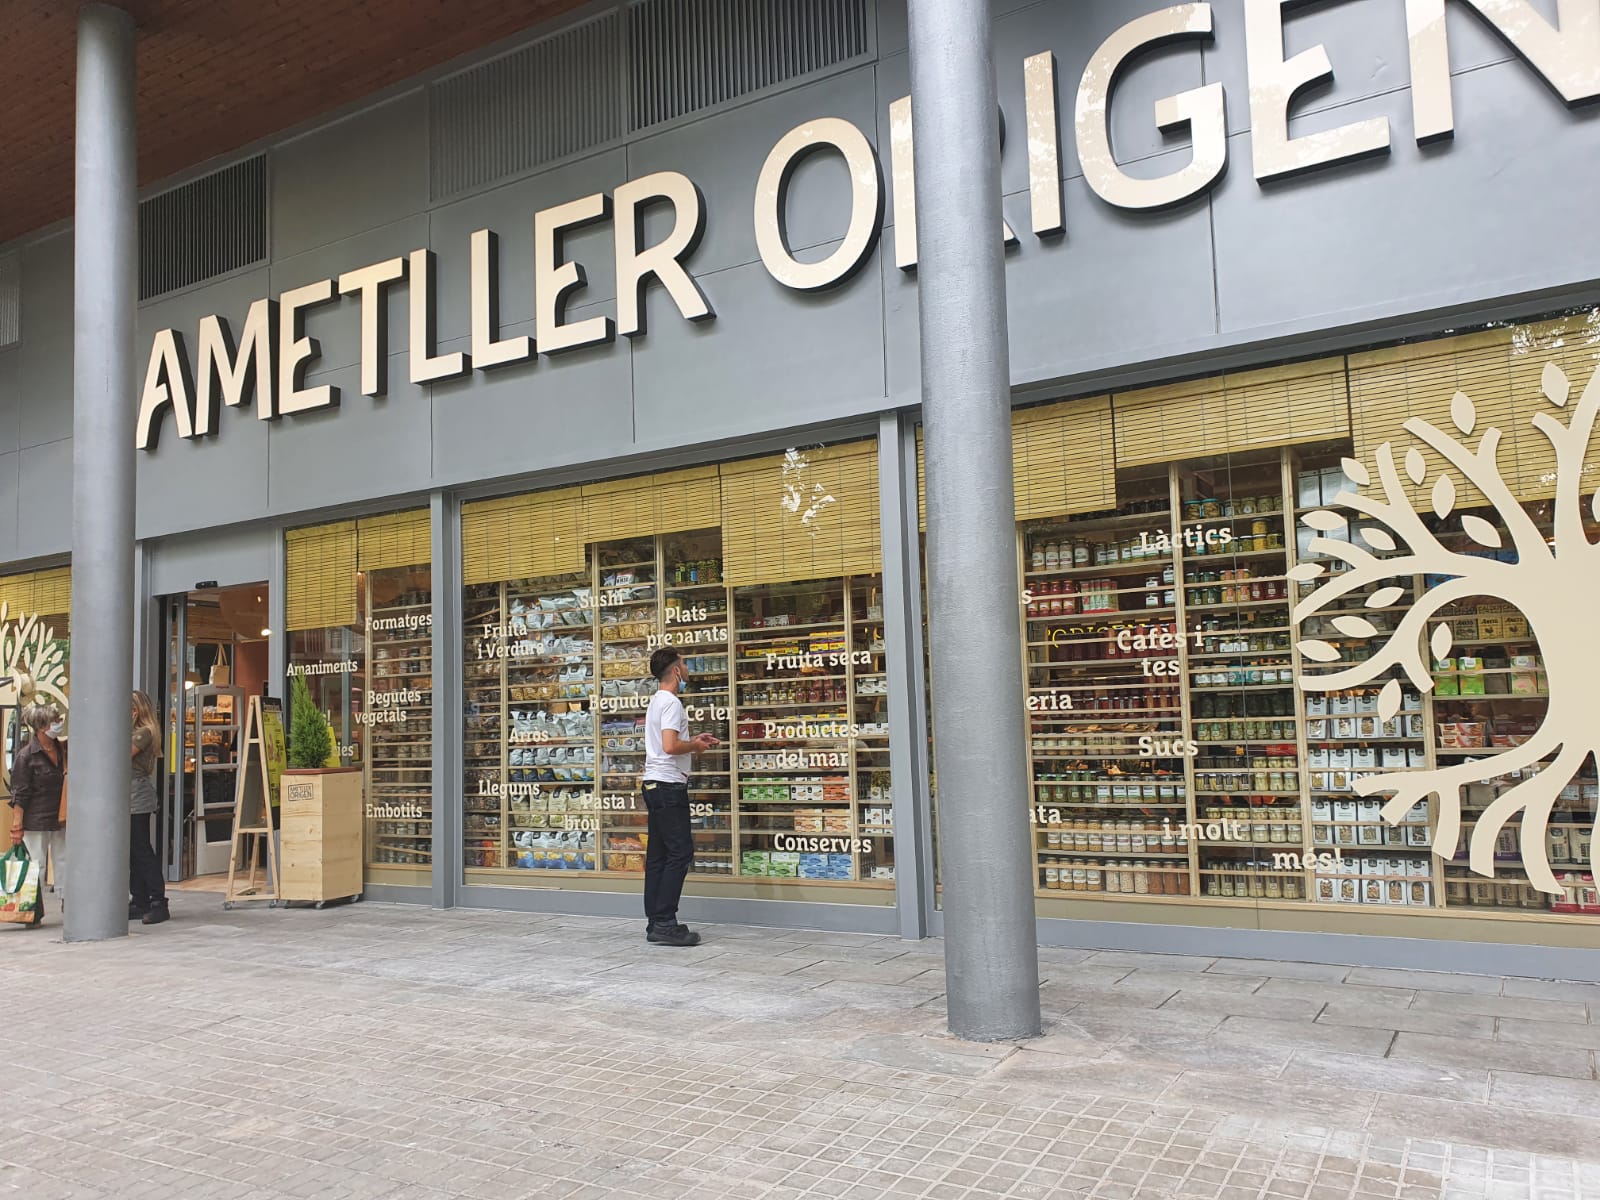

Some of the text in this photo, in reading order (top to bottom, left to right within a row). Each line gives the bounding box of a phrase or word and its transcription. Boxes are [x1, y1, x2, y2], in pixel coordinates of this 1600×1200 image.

[135, 0, 1600, 450] AMETLLER OIGEN
[1138, 524, 1232, 552] Làctics
[365, 613, 433, 631] Formatges
[664, 605, 707, 624] Plats
[483, 623, 528, 639] Fruita
[1117, 628, 1188, 651] Cafès
[1194, 625, 1205, 648] i
[486, 640, 545, 659] Verdura
[286, 659, 358, 676] Amaniments
[766, 650, 825, 671] Fruita
[829, 650, 872, 667] seca
[1142, 657, 1181, 677] tes
[367, 687, 422, 708] Begudes
[588, 691, 653, 713] Begude
[1025, 690, 1074, 711] eria
[354, 708, 407, 727] vegetals
[508, 727, 550, 743] Arròs
[763, 721, 860, 739] Productes
[1138, 737, 1199, 757] Sucs
[775, 749, 848, 768] del mar
[478, 780, 540, 799] Llegums
[366, 802, 423, 819] Embotits
[581, 792, 636, 810] Pasta i
[564, 815, 601, 831] brou
[1162, 818, 1243, 841] i molt
[774, 832, 872, 853] Conserves
[1272, 847, 1343, 870] més!
